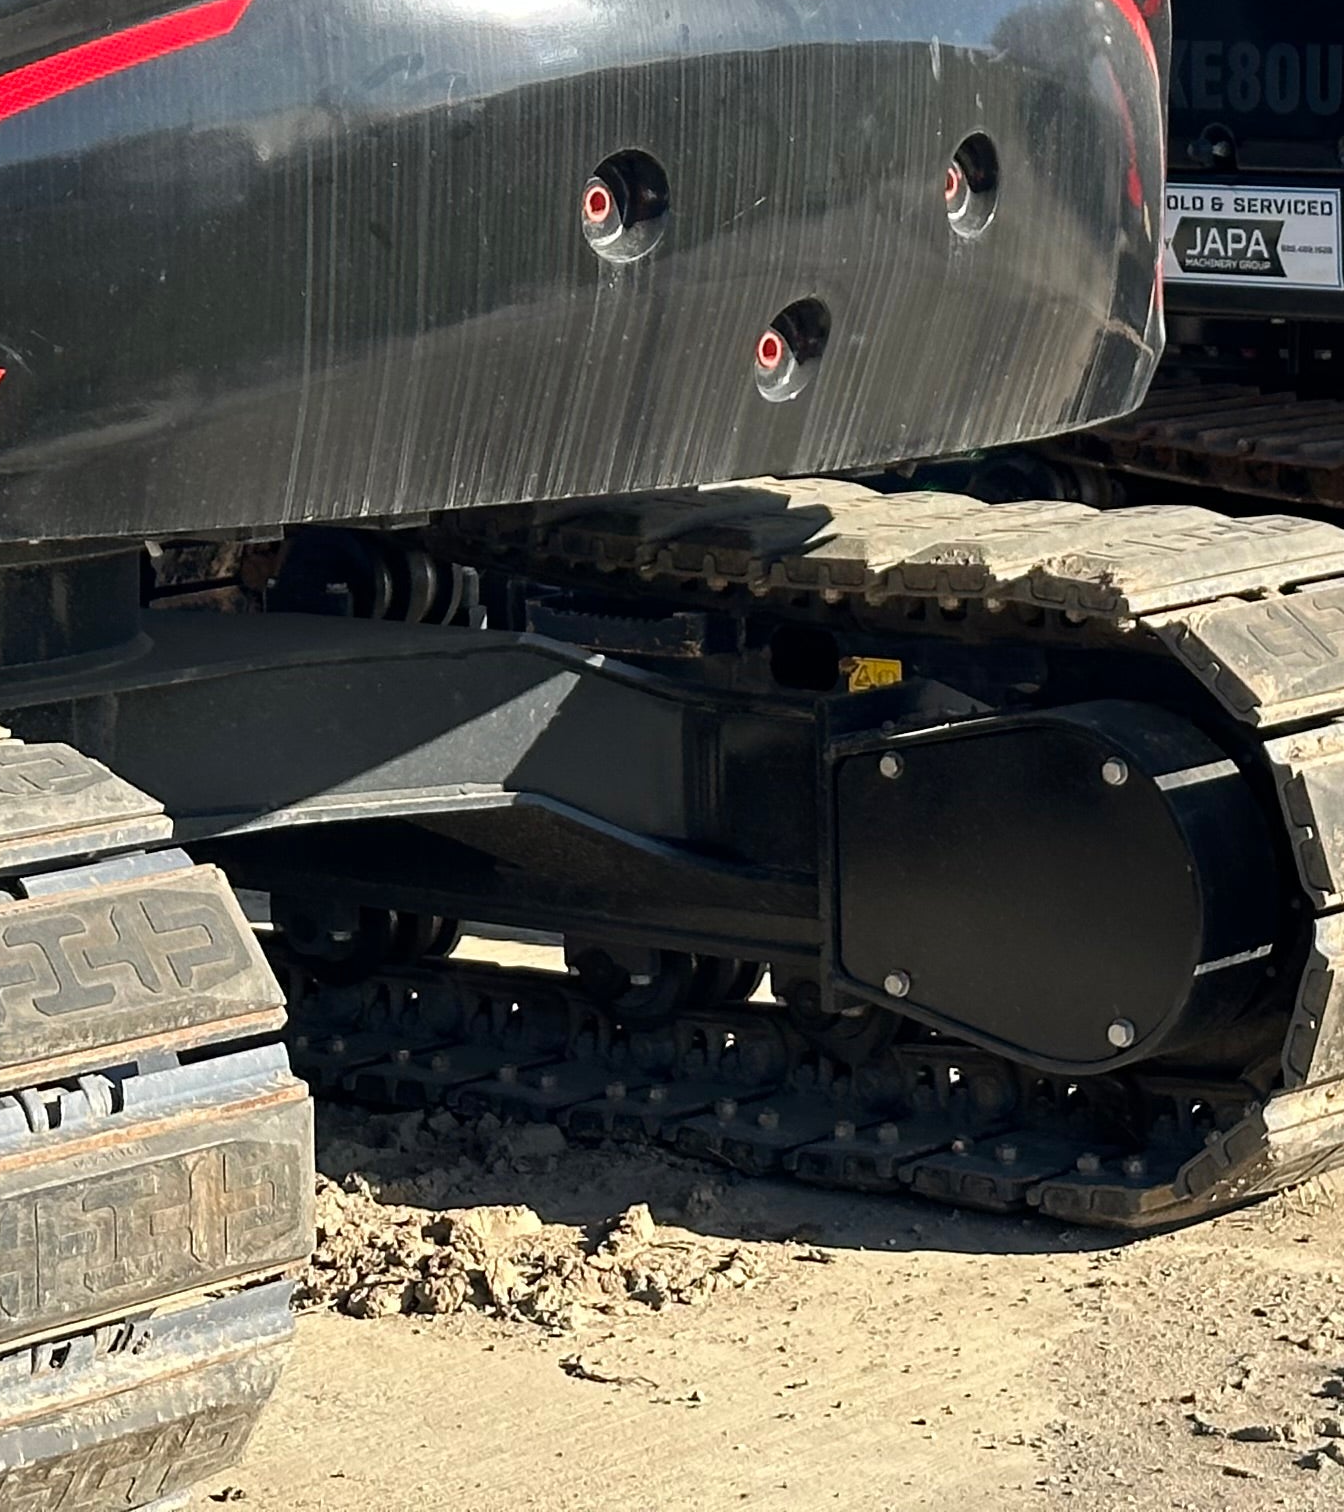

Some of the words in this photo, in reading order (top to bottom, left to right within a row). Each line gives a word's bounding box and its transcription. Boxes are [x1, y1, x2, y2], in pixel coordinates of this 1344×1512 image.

[1166, 194, 1204, 212] OLD
[1211, 196, 1224, 212] &
[1233, 197, 1334, 217] SERVICED
[1185, 226, 1270, 258] JAPA
[1184, 257, 1238, 271] MACHINERY
[1238, 260, 1272, 271] GROUP
